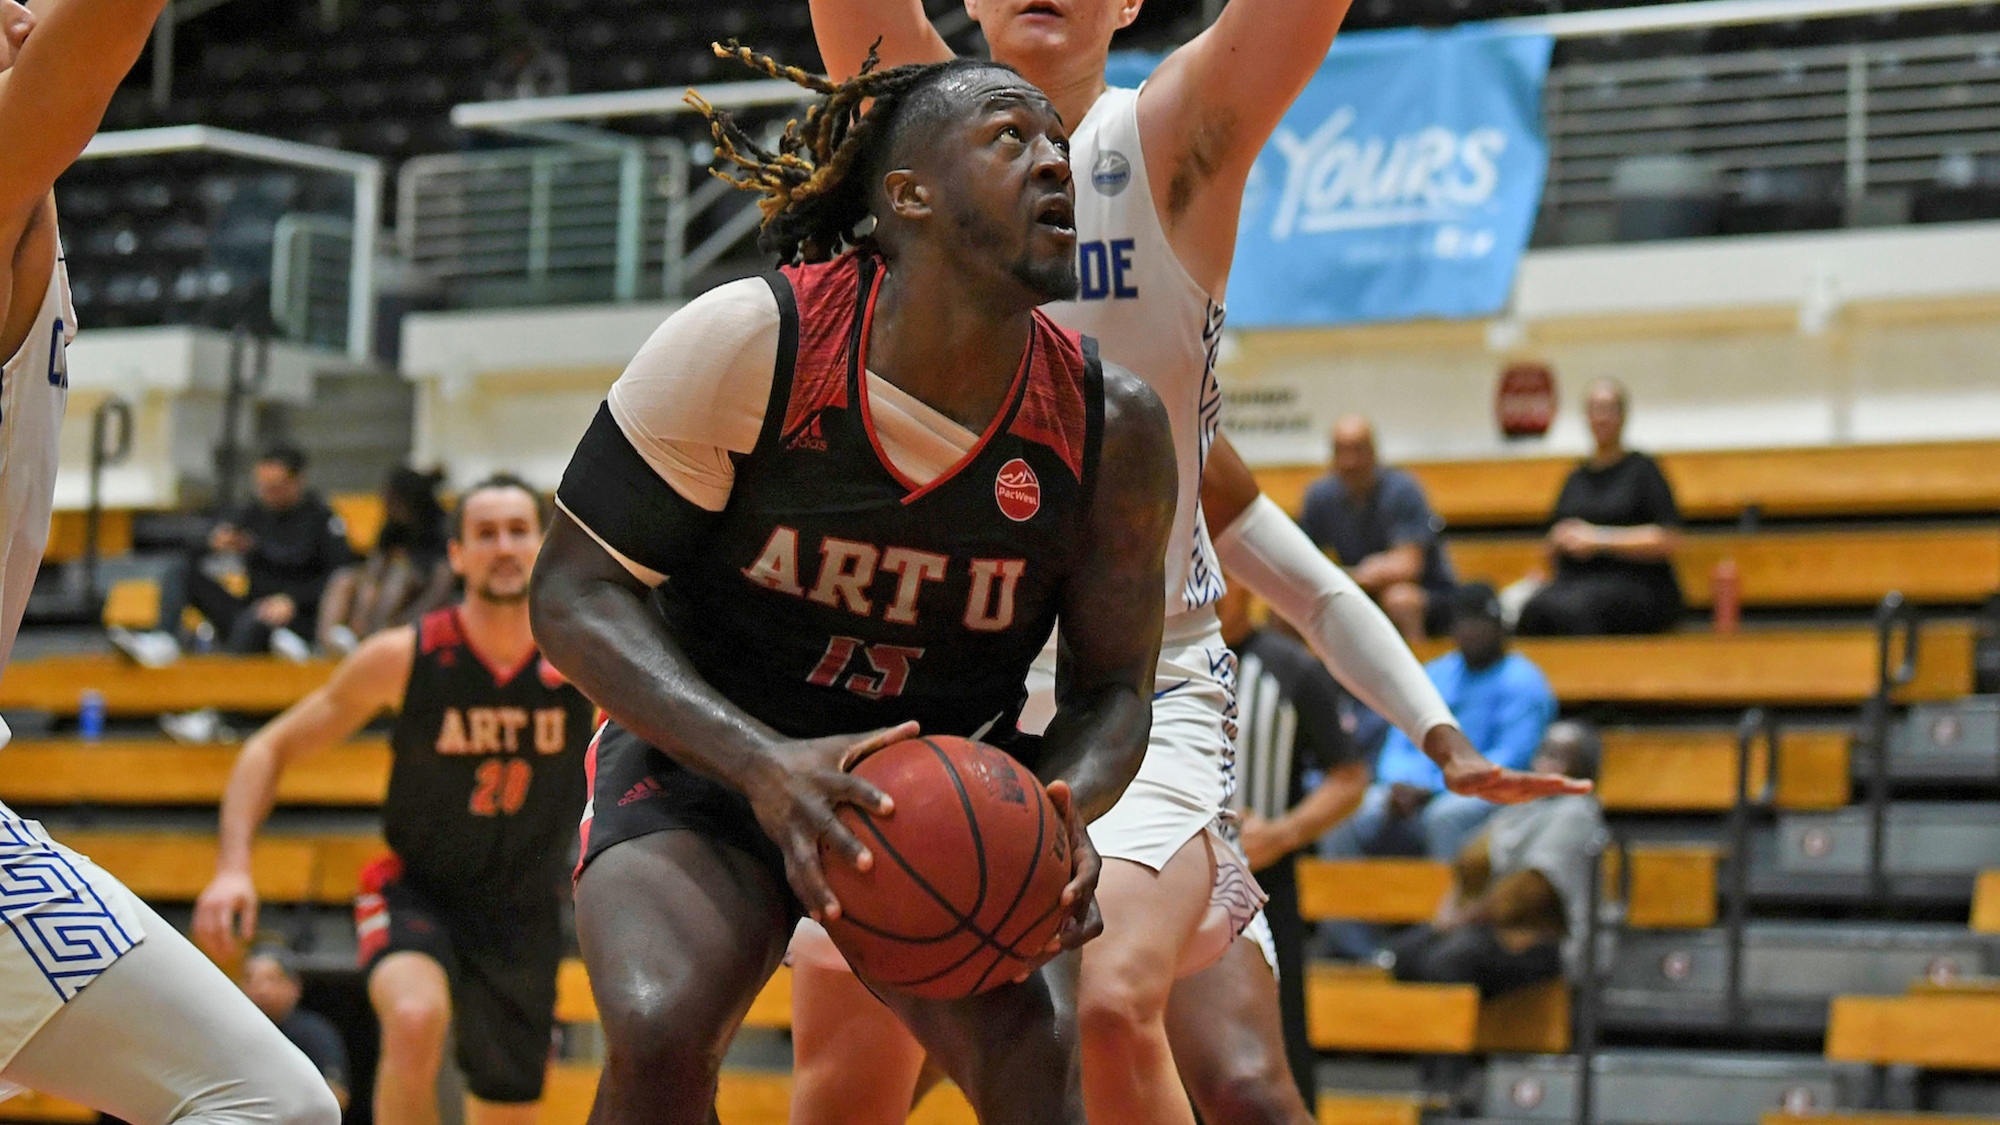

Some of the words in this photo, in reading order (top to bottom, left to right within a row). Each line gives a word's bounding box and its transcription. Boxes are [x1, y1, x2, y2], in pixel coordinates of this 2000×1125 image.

[998, 487, 1037, 505] PacWest
[740, 525, 949, 625] ART
[963, 558, 1026, 631] U
[806, 635, 925, 699] 15
[435, 706, 528, 754] ART
[534, 707, 566, 754] U
[469, 758, 533, 816] 20
